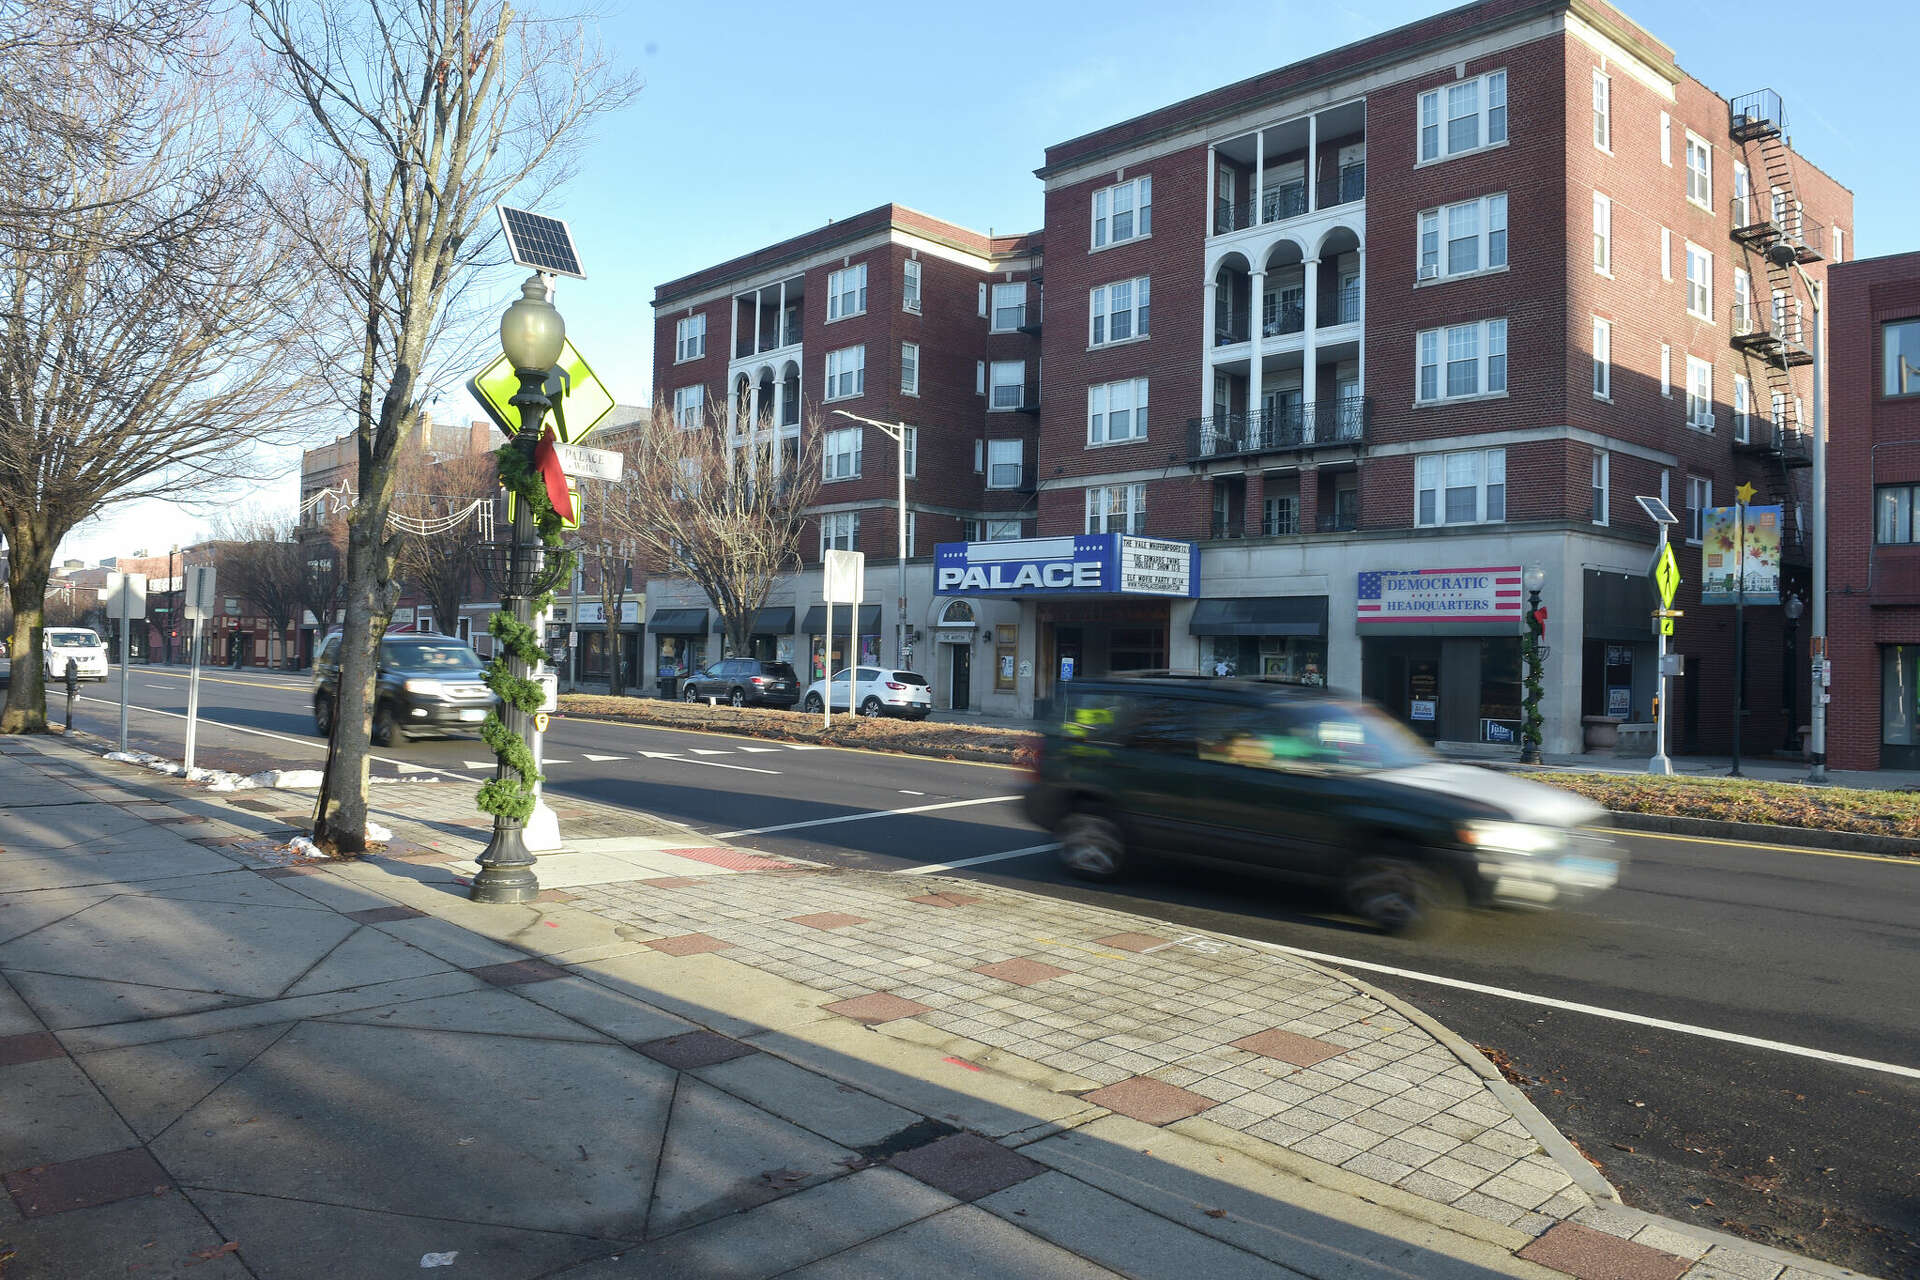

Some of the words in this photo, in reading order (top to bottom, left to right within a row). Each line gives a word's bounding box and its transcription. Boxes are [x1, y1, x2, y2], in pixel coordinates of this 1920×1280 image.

[565, 448, 605, 465] PALACE
[1124, 539, 1132, 548] THE
[938, 561, 1102, 590] PALACE
[1127, 574, 1136, 582] ELF
[1155, 576, 1169, 585] PARTY
[1387, 576, 1489, 591] DEMOCRATIC
[1387, 600, 1489, 612] HEADQUARTERS
